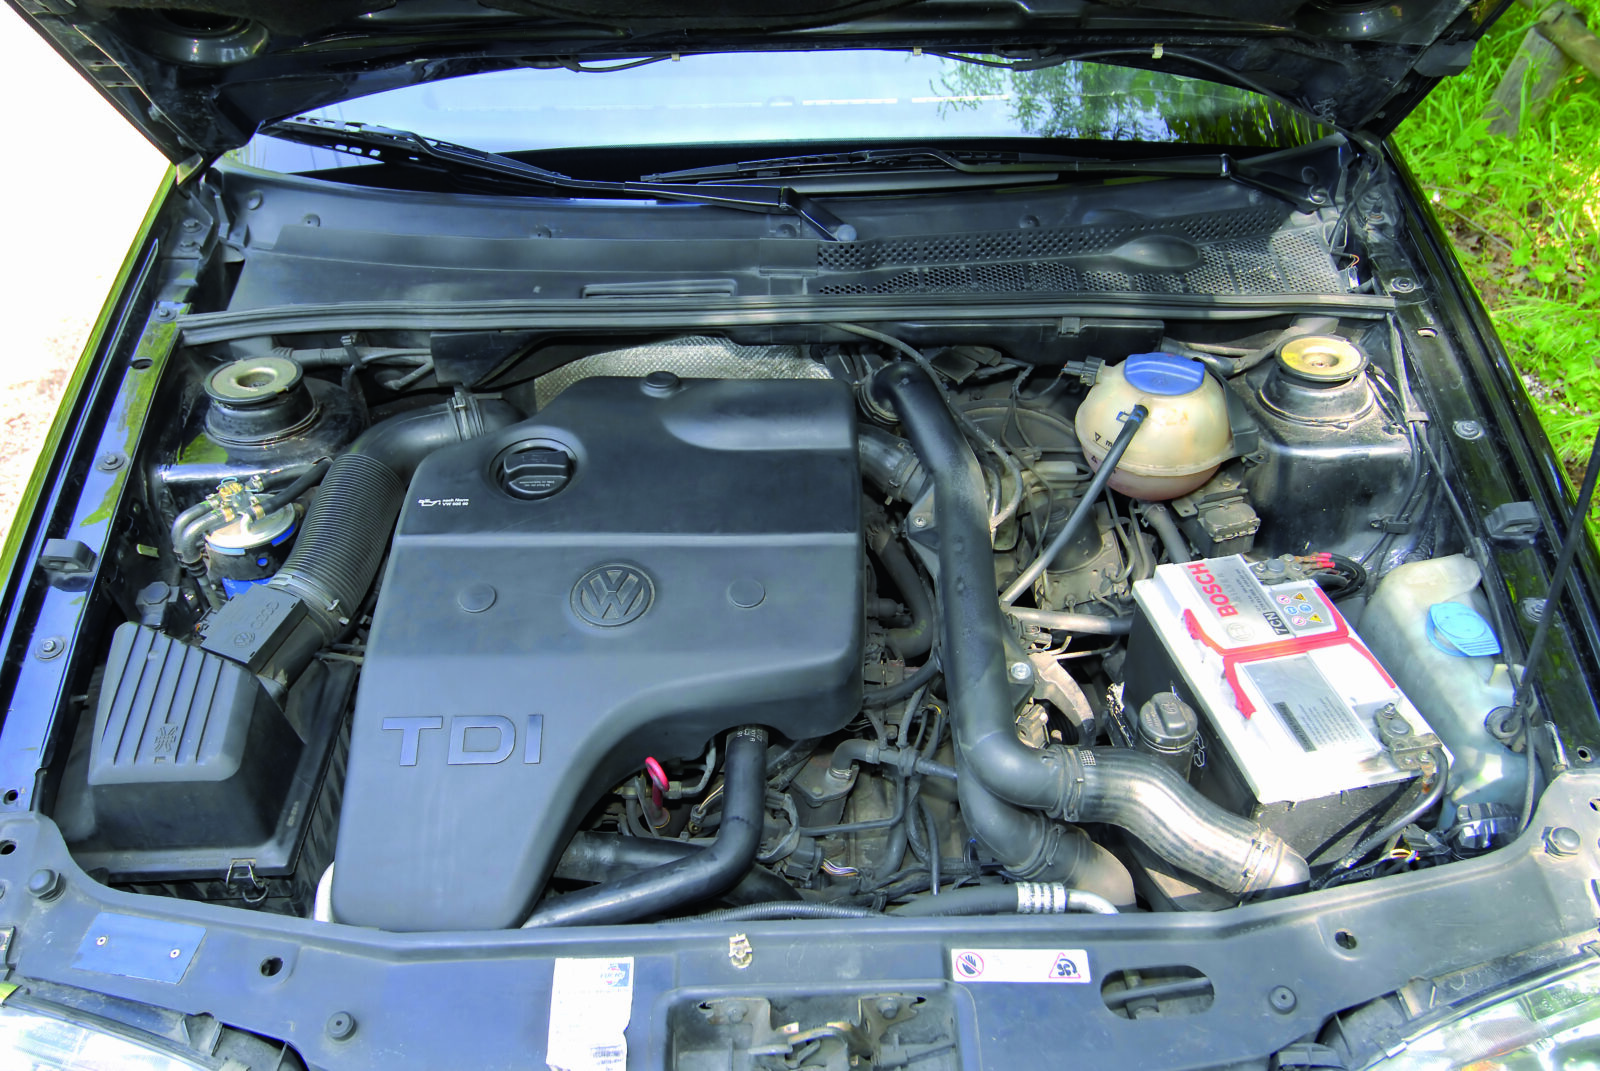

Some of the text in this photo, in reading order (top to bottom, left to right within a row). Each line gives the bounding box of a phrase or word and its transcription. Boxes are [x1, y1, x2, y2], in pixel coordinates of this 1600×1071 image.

[570, 563, 655, 627] VW
[1187, 563, 1239, 617] BOSCH
[1264, 612, 1289, 635] 7CN
[382, 714, 543, 767] TDI
